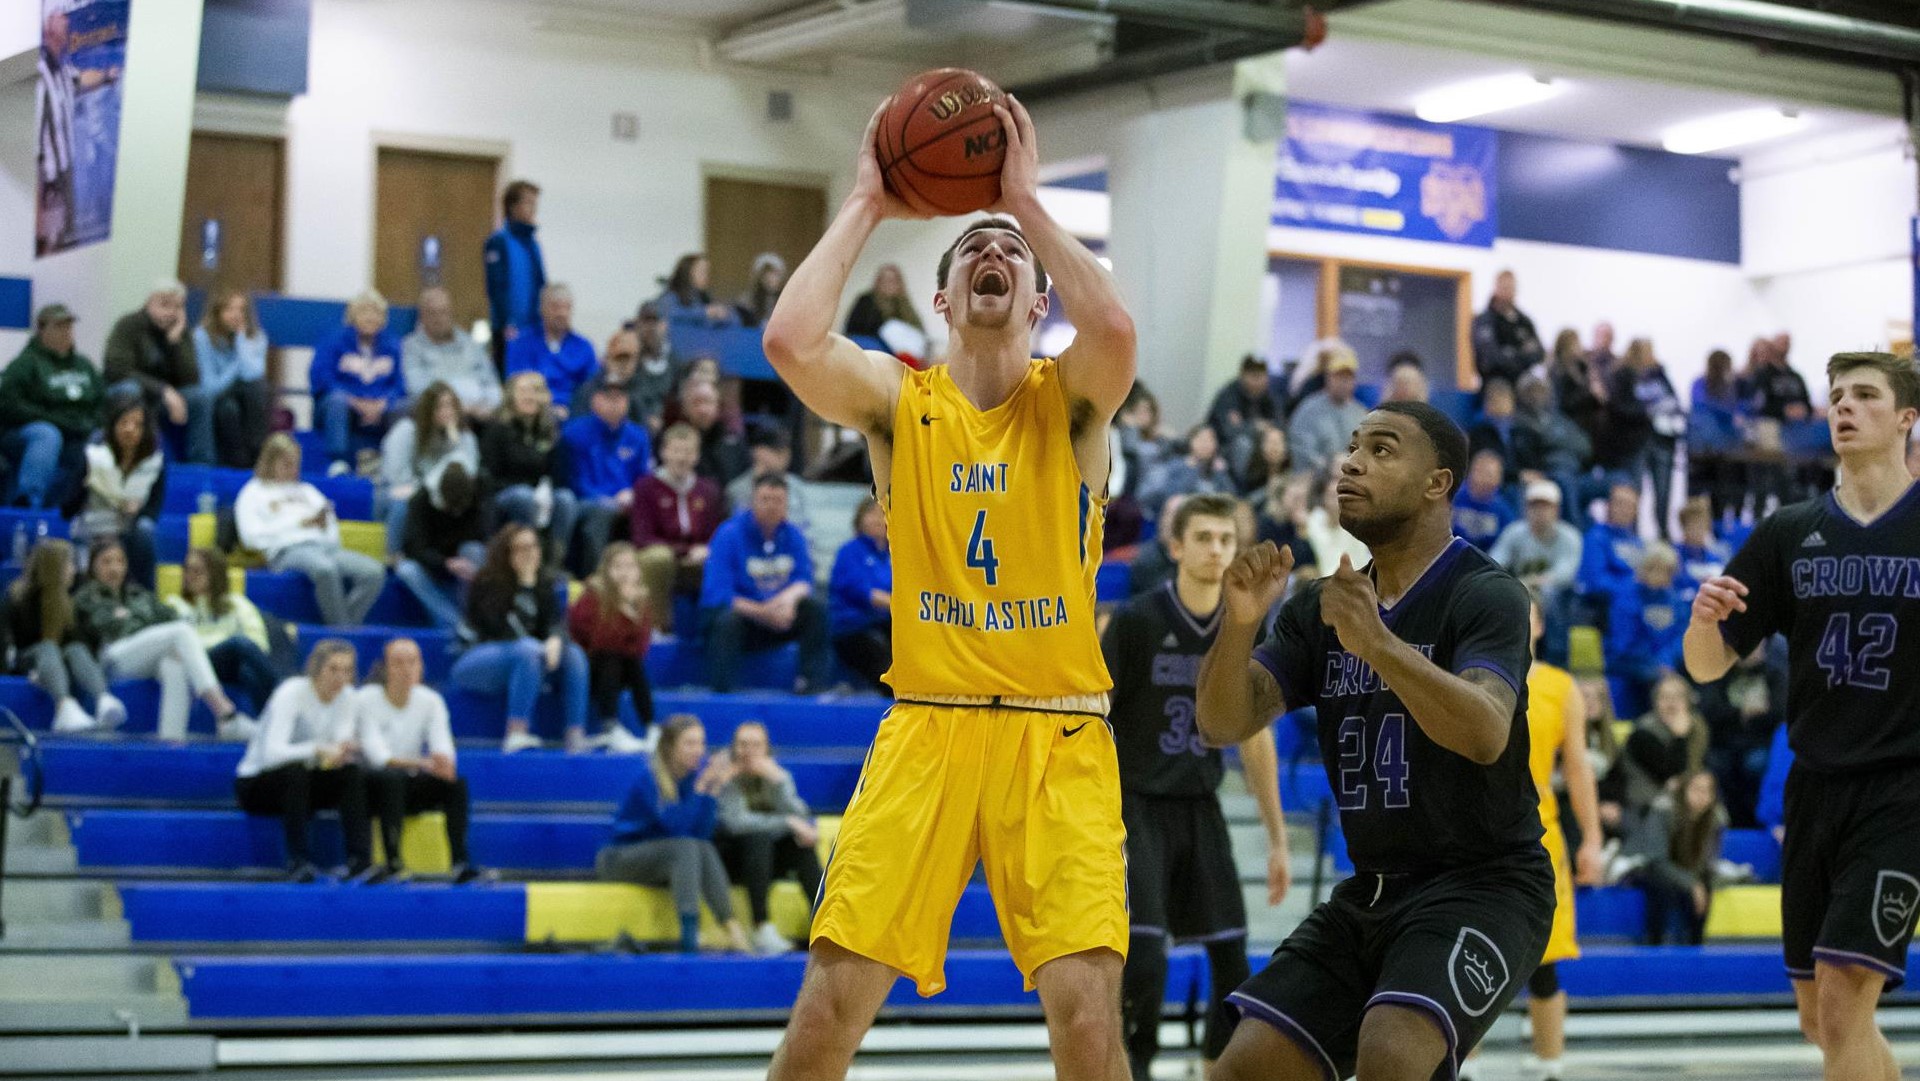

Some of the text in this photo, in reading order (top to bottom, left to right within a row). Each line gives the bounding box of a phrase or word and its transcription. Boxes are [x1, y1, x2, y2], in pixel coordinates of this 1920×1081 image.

[950, 463, 1009, 492] SAINT
[966, 508, 998, 586] 4
[919, 590, 1068, 632] SCHOASTICA
[1319, 643, 1436, 698] CRO
[1816, 612, 1898, 691] 42
[1159, 696, 1208, 756] 3
[1338, 713, 1410, 809] 24
